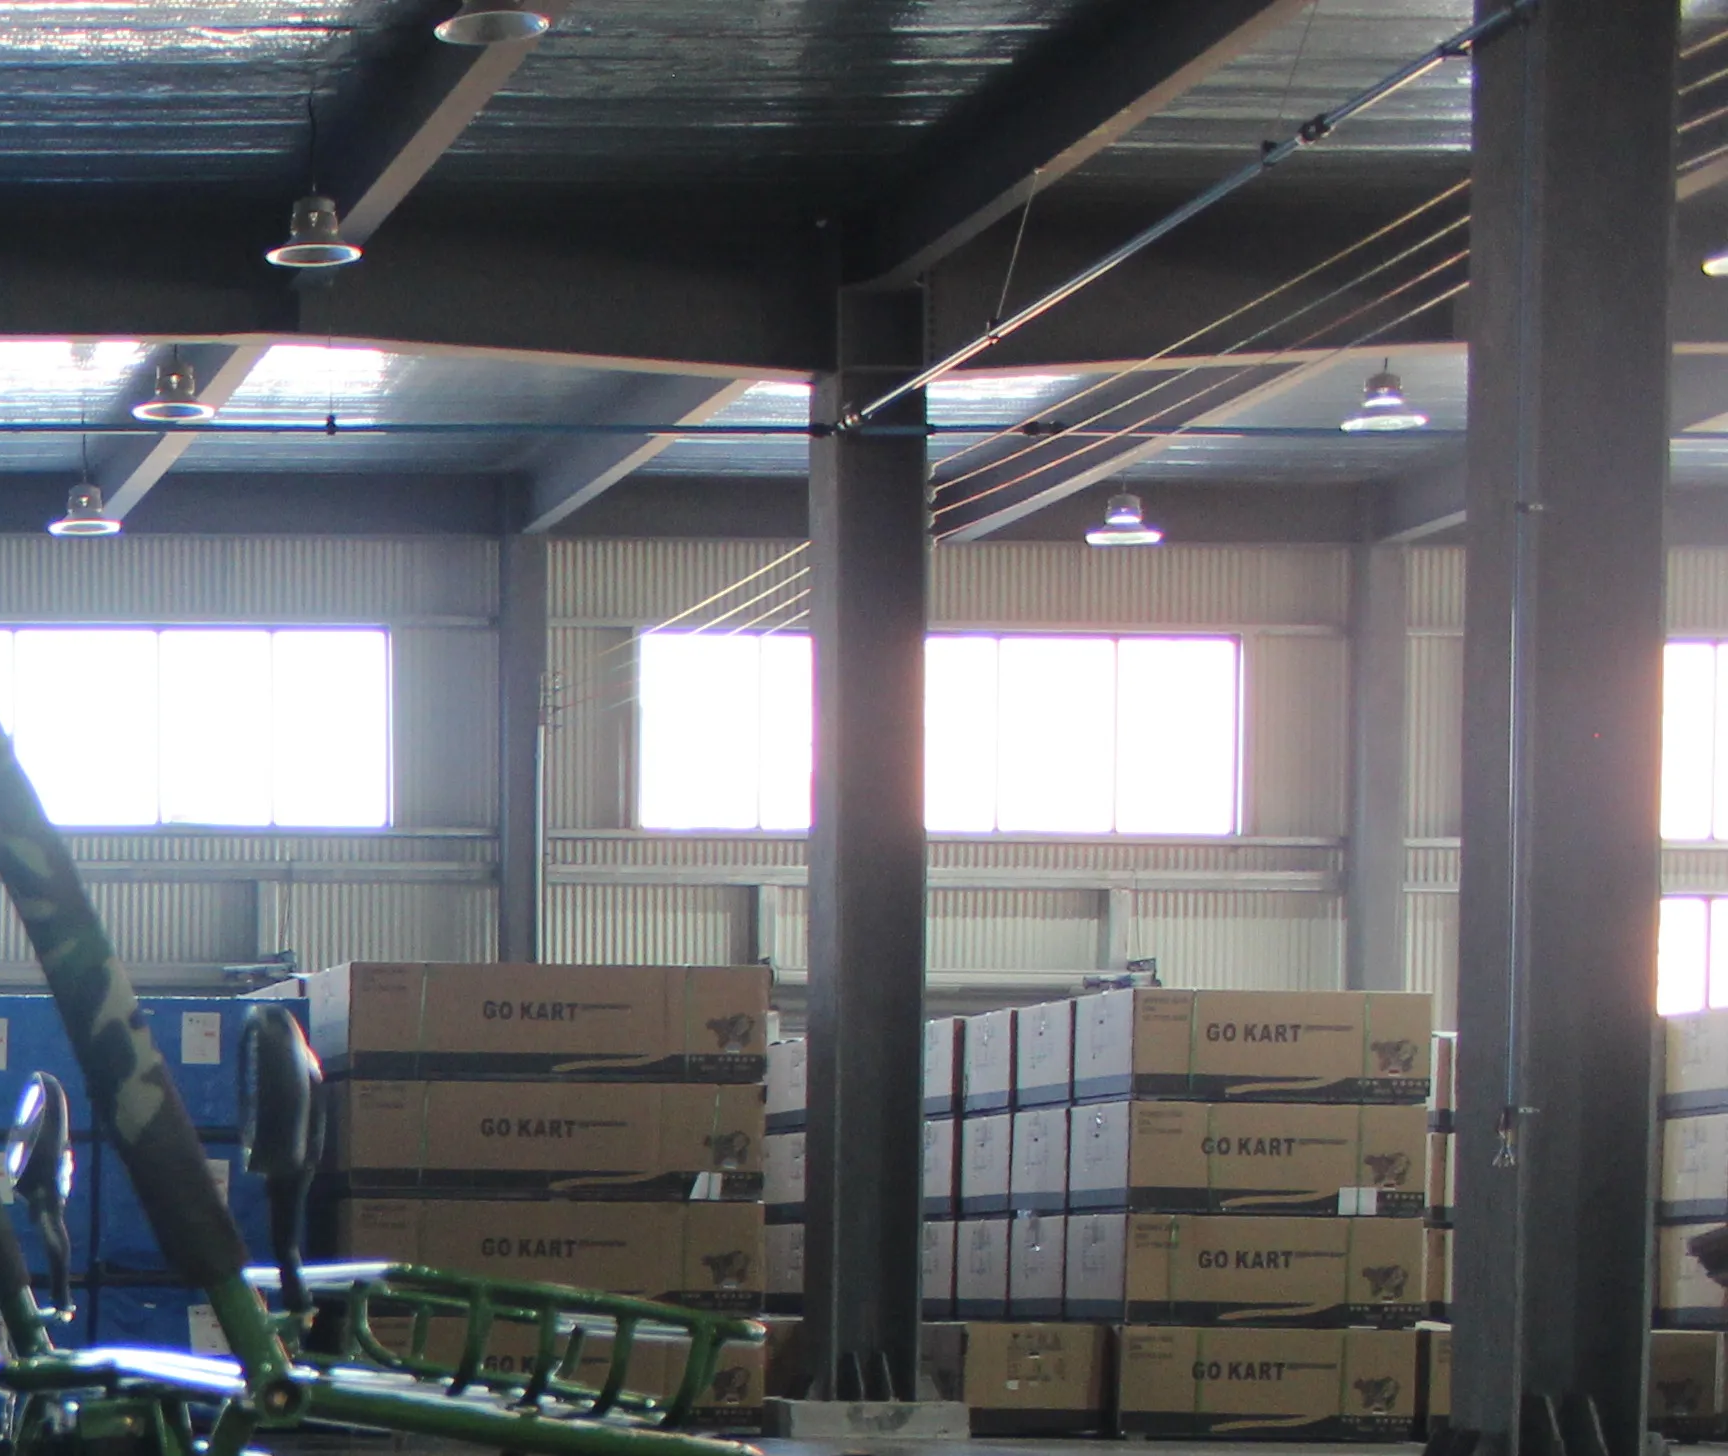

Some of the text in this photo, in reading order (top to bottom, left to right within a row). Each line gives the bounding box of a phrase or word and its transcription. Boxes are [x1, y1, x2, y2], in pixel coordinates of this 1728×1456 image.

[482, 1001, 578, 1020] GO KART
[1205, 1022, 1301, 1043] GO KART
[480, 1119, 511, 1137] GO
[517, 1119, 576, 1138] KART
[1200, 1136, 1230, 1155] GO
[1237, 1137, 1295, 1156] KART
[480, 1237, 577, 1258] GO KART
[1198, 1249, 1228, 1268] GO
[1235, 1249, 1292, 1268] KART
[484, 1355, 514, 1373] GO
[1191, 1360, 1221, 1380] GO
[1227, 1361, 1285, 1380] KART
